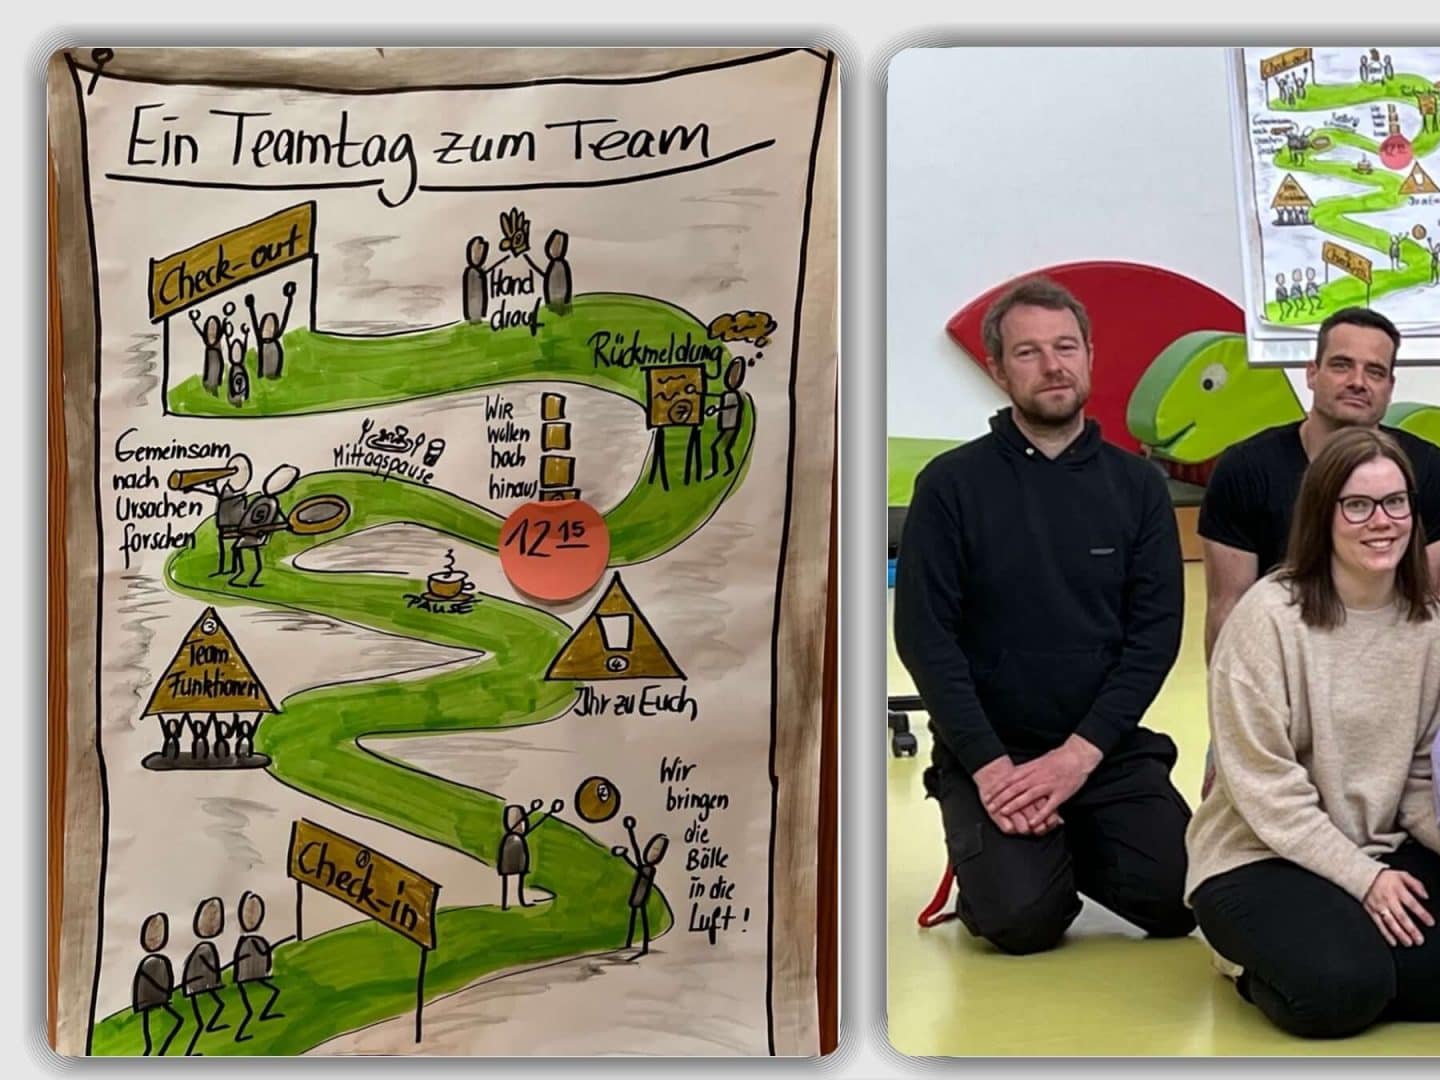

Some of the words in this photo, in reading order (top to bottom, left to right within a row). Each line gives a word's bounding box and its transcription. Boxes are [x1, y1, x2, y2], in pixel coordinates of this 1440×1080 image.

[127, 103, 200, 167] Ein
[209, 109, 418, 208] Teamtag
[433, 130, 536, 164] zum
[544, 118, 710, 161] Team
[159, 223, 303, 306] Check-out
[490, 269, 534, 298] Hand
[588, 330, 723, 380] Rückmeldung
[115, 427, 231, 463] Gemeinsam
[113, 466, 160, 491] nach
[333, 442, 435, 485] Mittagspause
[116, 492, 203, 522] Ursachen
[120, 522, 196, 570] forschen
[638, 684, 698, 722] Euch
[660, 756, 697, 784] Wir
[666, 786, 730, 822] bringen
[684, 820, 710, 844] die
[298, 841, 419, 932] Check-in
[689, 876, 705, 899] in
[710, 875, 735, 900] die
